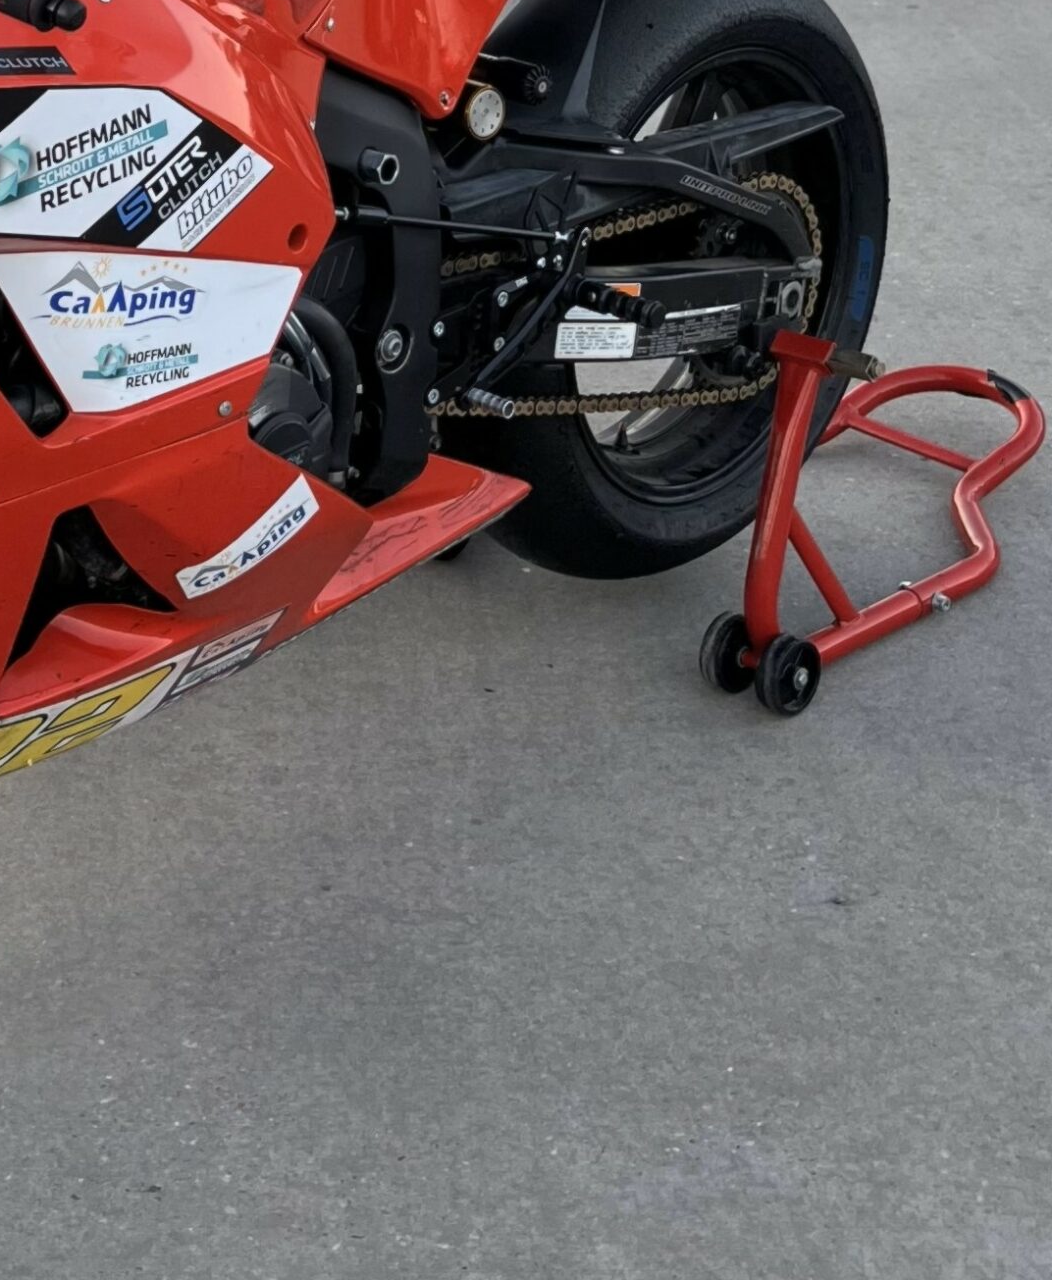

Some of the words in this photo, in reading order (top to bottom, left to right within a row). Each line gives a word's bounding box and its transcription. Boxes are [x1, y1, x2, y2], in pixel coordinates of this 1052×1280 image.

[34, 103, 152, 171] HOFFMANN
[37, 153, 94, 190] SCHROTT
[108, 129, 154, 158] METALL
[39, 145, 157, 213] RECYCLING
[116, 135, 208, 231] SUTER
[157, 151, 223, 221] CLUTCH
[176, 154, 253, 240] bitubo
[49, 314, 126, 329] BRUNNEN
[127, 342, 192, 365] HOFFMANN
[125, 366, 190, 389] RECYCLING
